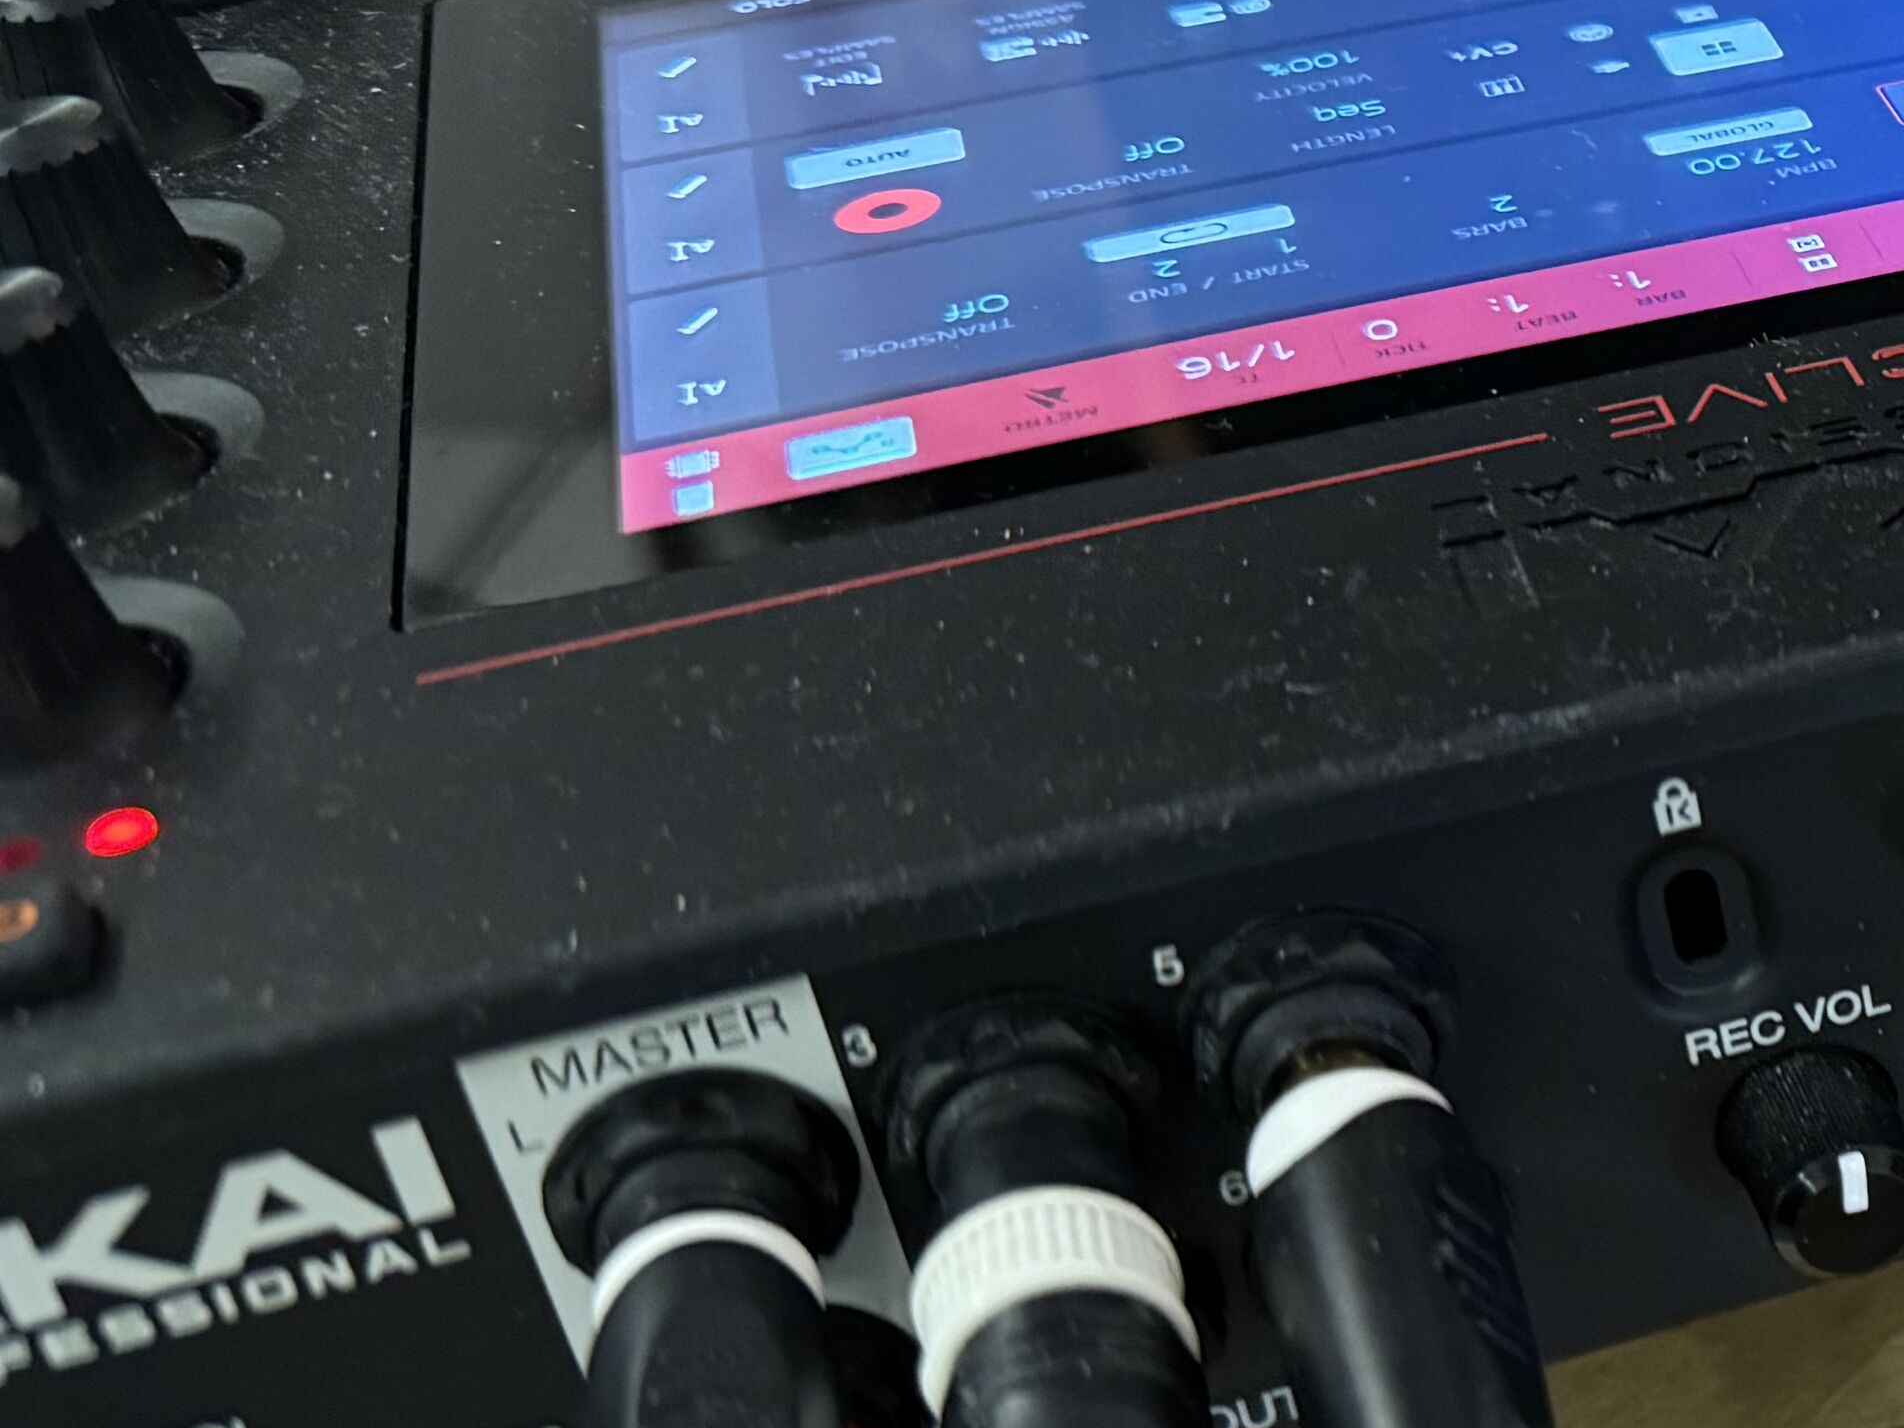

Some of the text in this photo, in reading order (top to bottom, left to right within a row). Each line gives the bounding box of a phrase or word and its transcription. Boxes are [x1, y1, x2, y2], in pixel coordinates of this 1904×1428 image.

[1259, 48, 1359, 78] 100%
[1252, 72, 1372, 102] VELOCITY
[1311, 95, 1386, 126] Seq
[1288, 123, 1396, 152] LENGTH
[1688, 120, 1774, 144] GLOBAL
[844, 148, 910, 168] AUTO
[1120, 135, 1185, 162] Off
[1688, 137, 1821, 177] 127.00
[1030, 162, 1192, 202] TRANSPOSE
[1775, 157, 1838, 179] BPM
[1486, 193, 1518, 214] 2
[1451, 215, 1528, 240] BARS
[1150, 257, 1181, 279] 2
[1230, 258, 1309, 283] START
[940, 291, 1010, 322] Off
[1127, 282, 1186, 303] END
[1633, 287, 1686, 307] BAR
[1360, 316, 1401, 343] 0
[1512, 309, 1576, 330] BEAT
[838, 316, 1014, 362] TRANSPOSE
[1371, 340, 1427, 359] TICK
[1173, 336, 1296, 381] 1/16
[1597, 356, 1867, 440] LIVE
[1002, 404, 1099, 434] METRO
[1152, 945, 1185, 987] 5
[1684, 984, 1893, 1067] REC VOL
[529, 997, 792, 1098] MASTER
[841, 1025, 878, 1069] 3
[507, 1118, 545, 1157] L
[1218, 1169, 1250, 1207] 6
[0, 1115, 457, 1334] KAI
